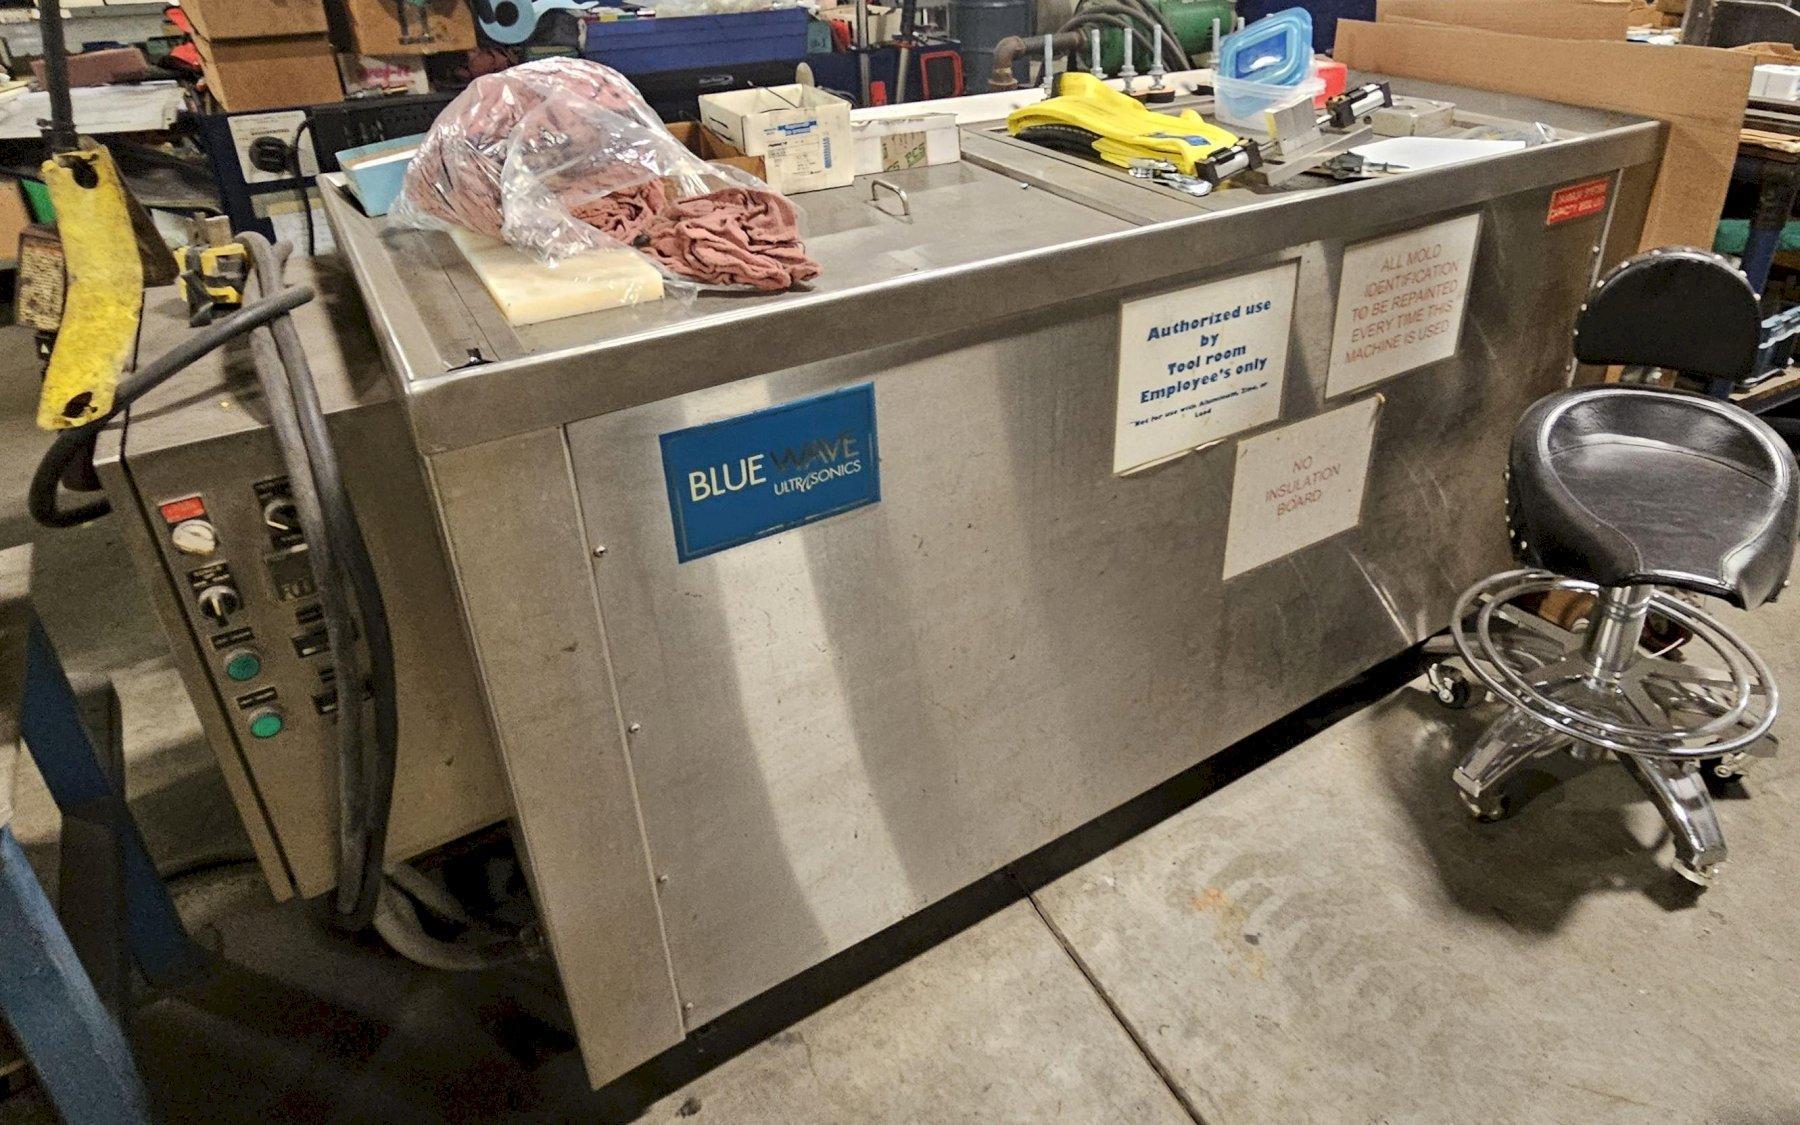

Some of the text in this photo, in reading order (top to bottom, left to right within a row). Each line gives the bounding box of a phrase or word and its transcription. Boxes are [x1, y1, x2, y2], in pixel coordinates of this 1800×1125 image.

[1380, 243, 1442, 273] ALL MOLD
[1362, 260, 1459, 298] IDENTIFICATION
[1147, 299, 1271, 341] Authorized use
[1351, 279, 1458, 323] TO BE REPAINTED
[1200, 333, 1219, 347] by
[1351, 299, 1454, 343] EVERY TIME THIS
[1167, 345, 1246, 375] Tool room
[1345, 319, 1450, 363] MACHINE IS USED
[1140, 356, 1268, 403] Employee's only
[688, 431, 861, 502] BLUE WAVE
[774, 459, 862, 496] ULTRASONICS
[1265, 463, 1341, 503] INSULATION
[1292, 455, 1313, 473] NO
[1276, 489, 1322, 517] BOARD
